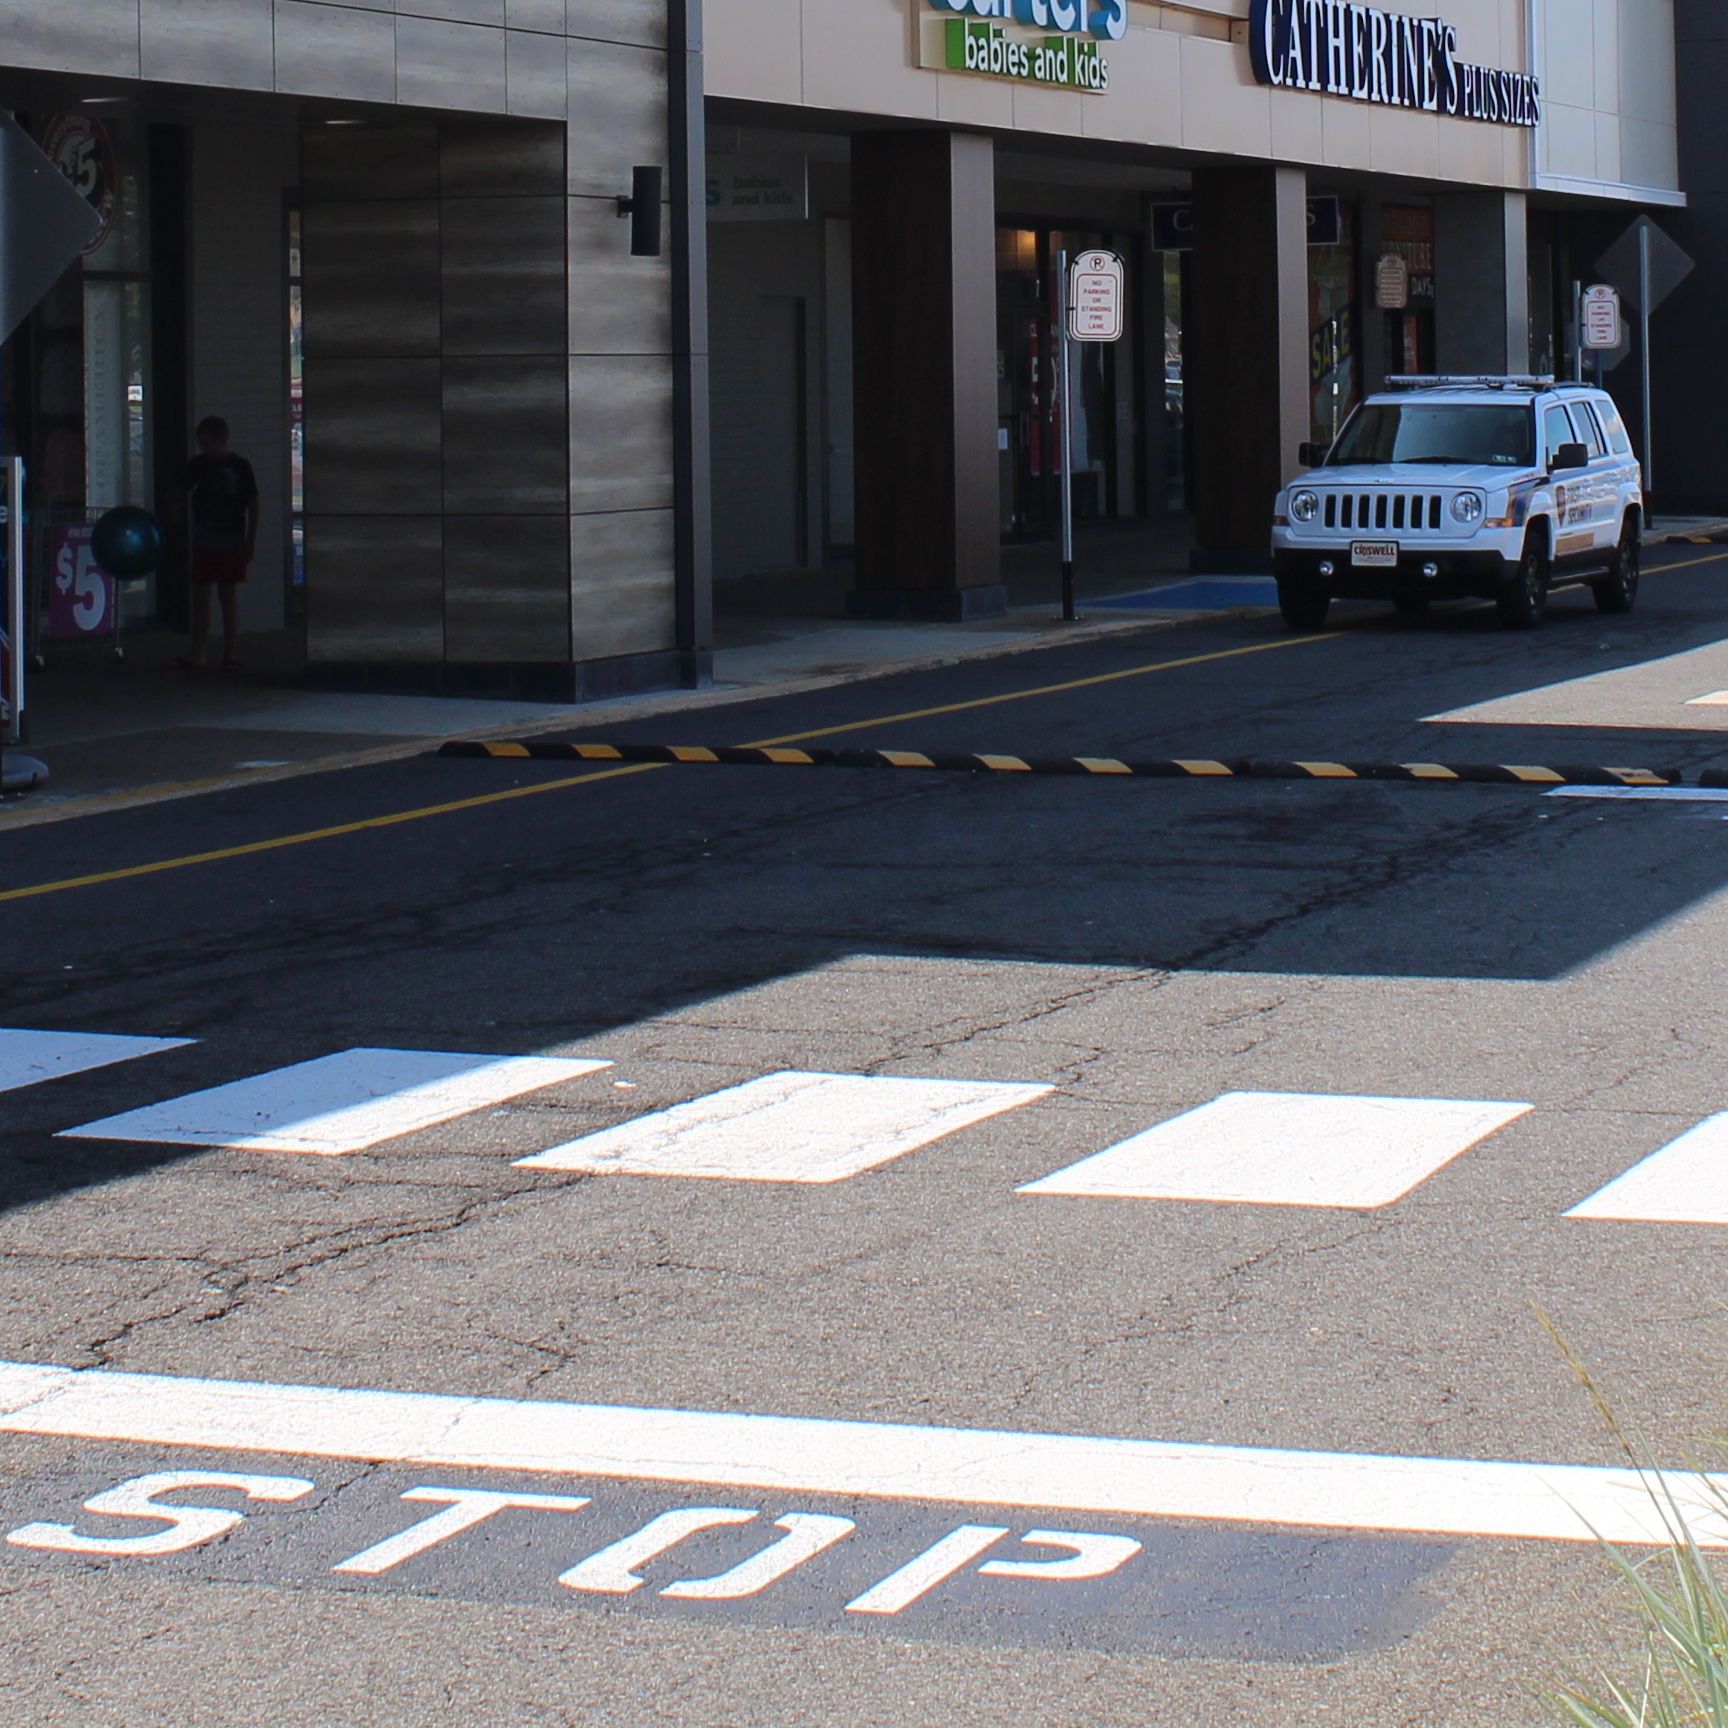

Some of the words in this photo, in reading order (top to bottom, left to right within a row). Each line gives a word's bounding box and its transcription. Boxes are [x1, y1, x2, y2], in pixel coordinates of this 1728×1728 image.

[960, 27, 1029, 77] babies
[1034, 36, 1068, 85] and
[1072, 39, 1109, 90] kids
[1462, 62, 1498, 121] PLUS
[1499, 70, 1540, 128] SIZES
[1312, 311, 1350, 379] SAE
[56, 542, 106, 631] $5
[6, 1469, 1142, 1616] STOP
